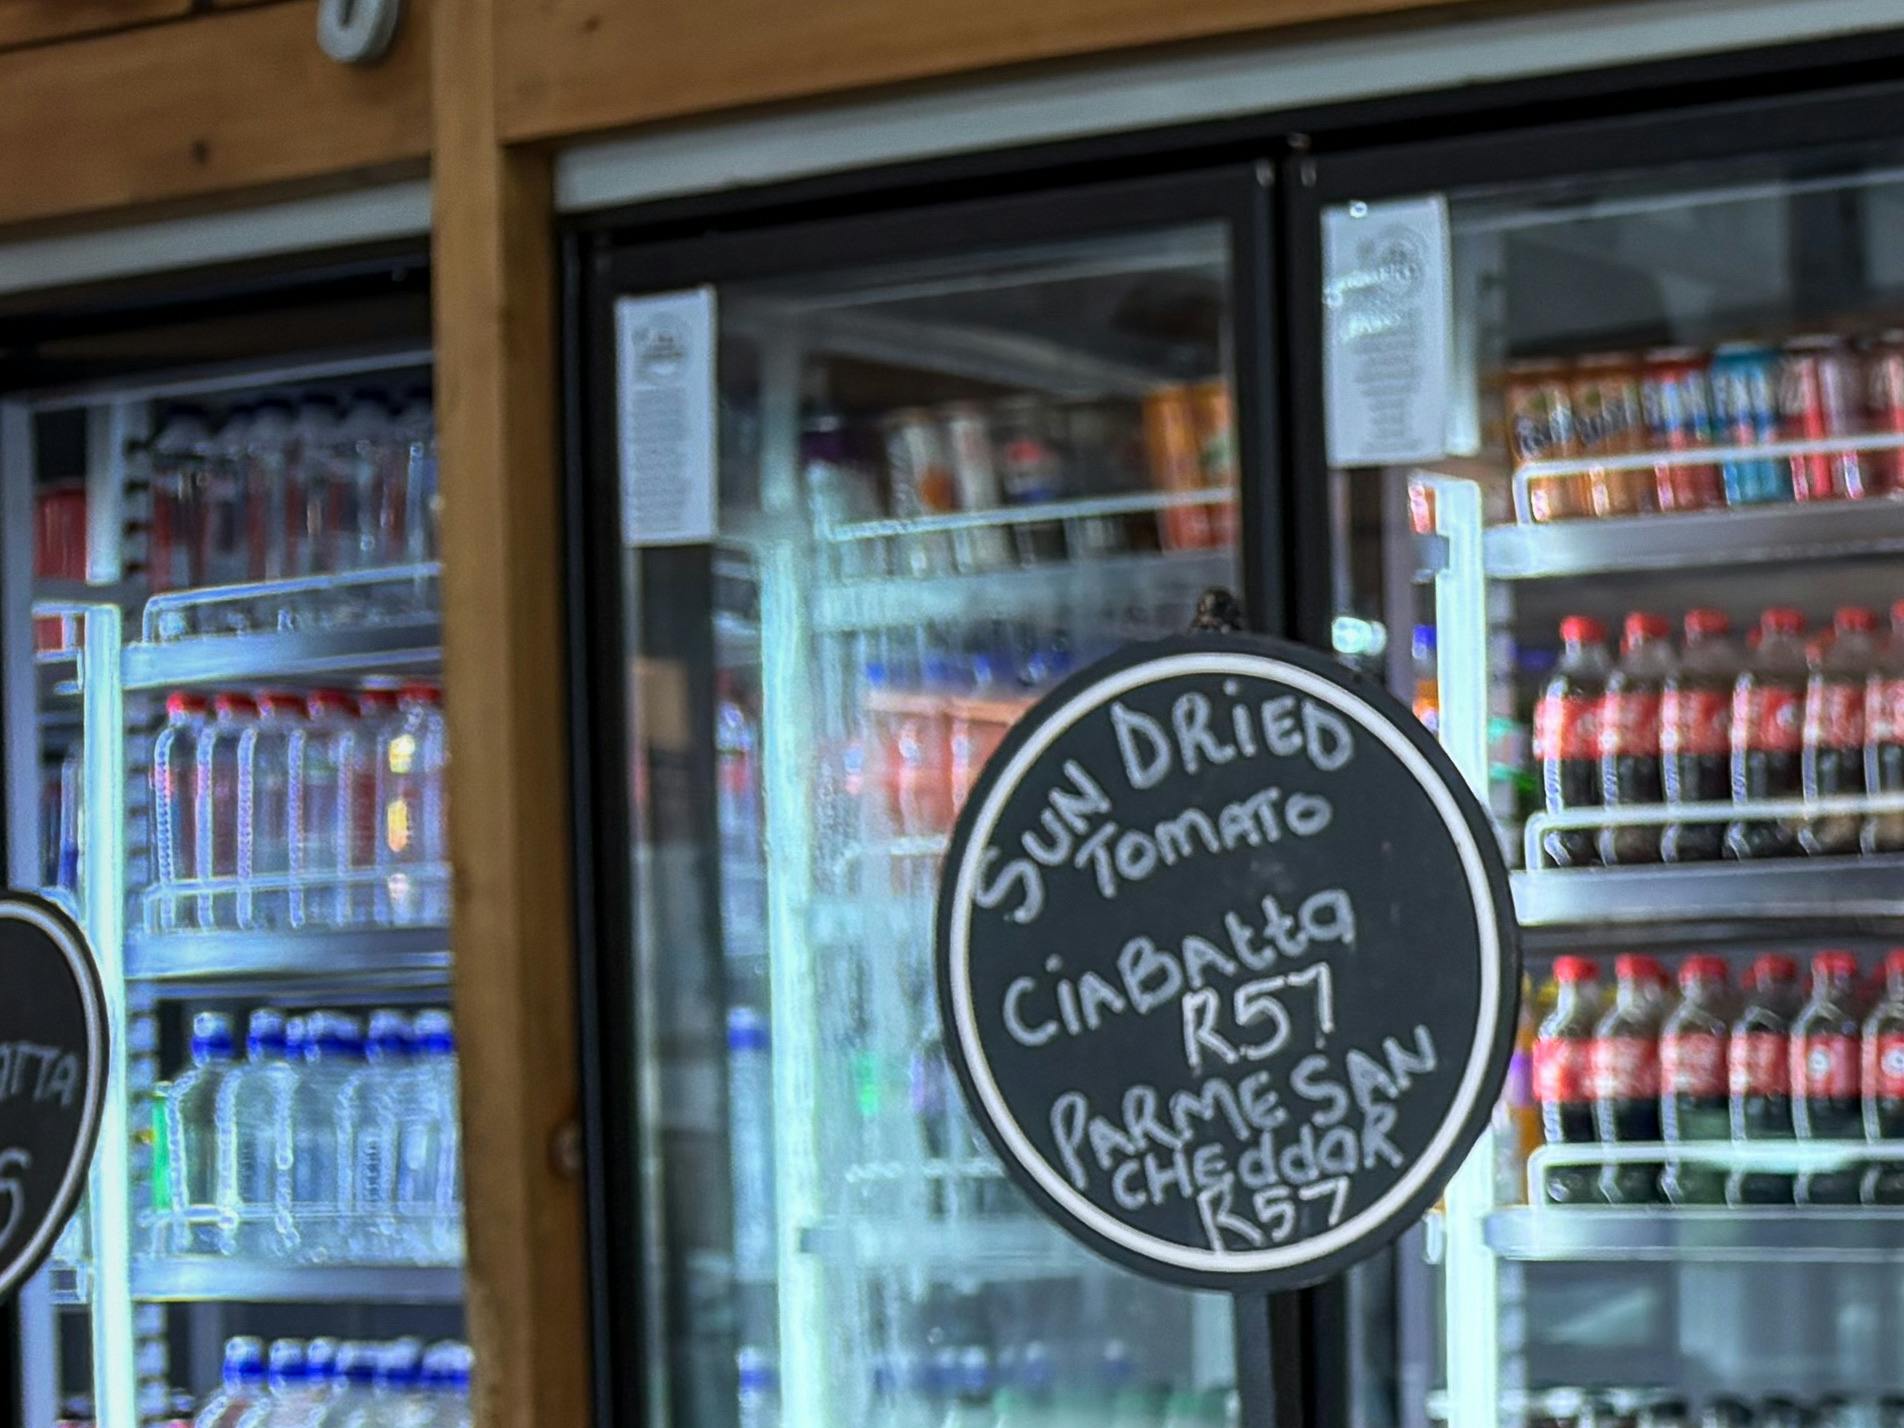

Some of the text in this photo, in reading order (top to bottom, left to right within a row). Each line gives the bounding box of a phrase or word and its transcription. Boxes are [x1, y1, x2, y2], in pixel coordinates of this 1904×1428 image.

[973, 761, 1111, 923] SUN
[1182, 962, 1335, 1069] R57
[1196, 1174, 1349, 1254] R57
